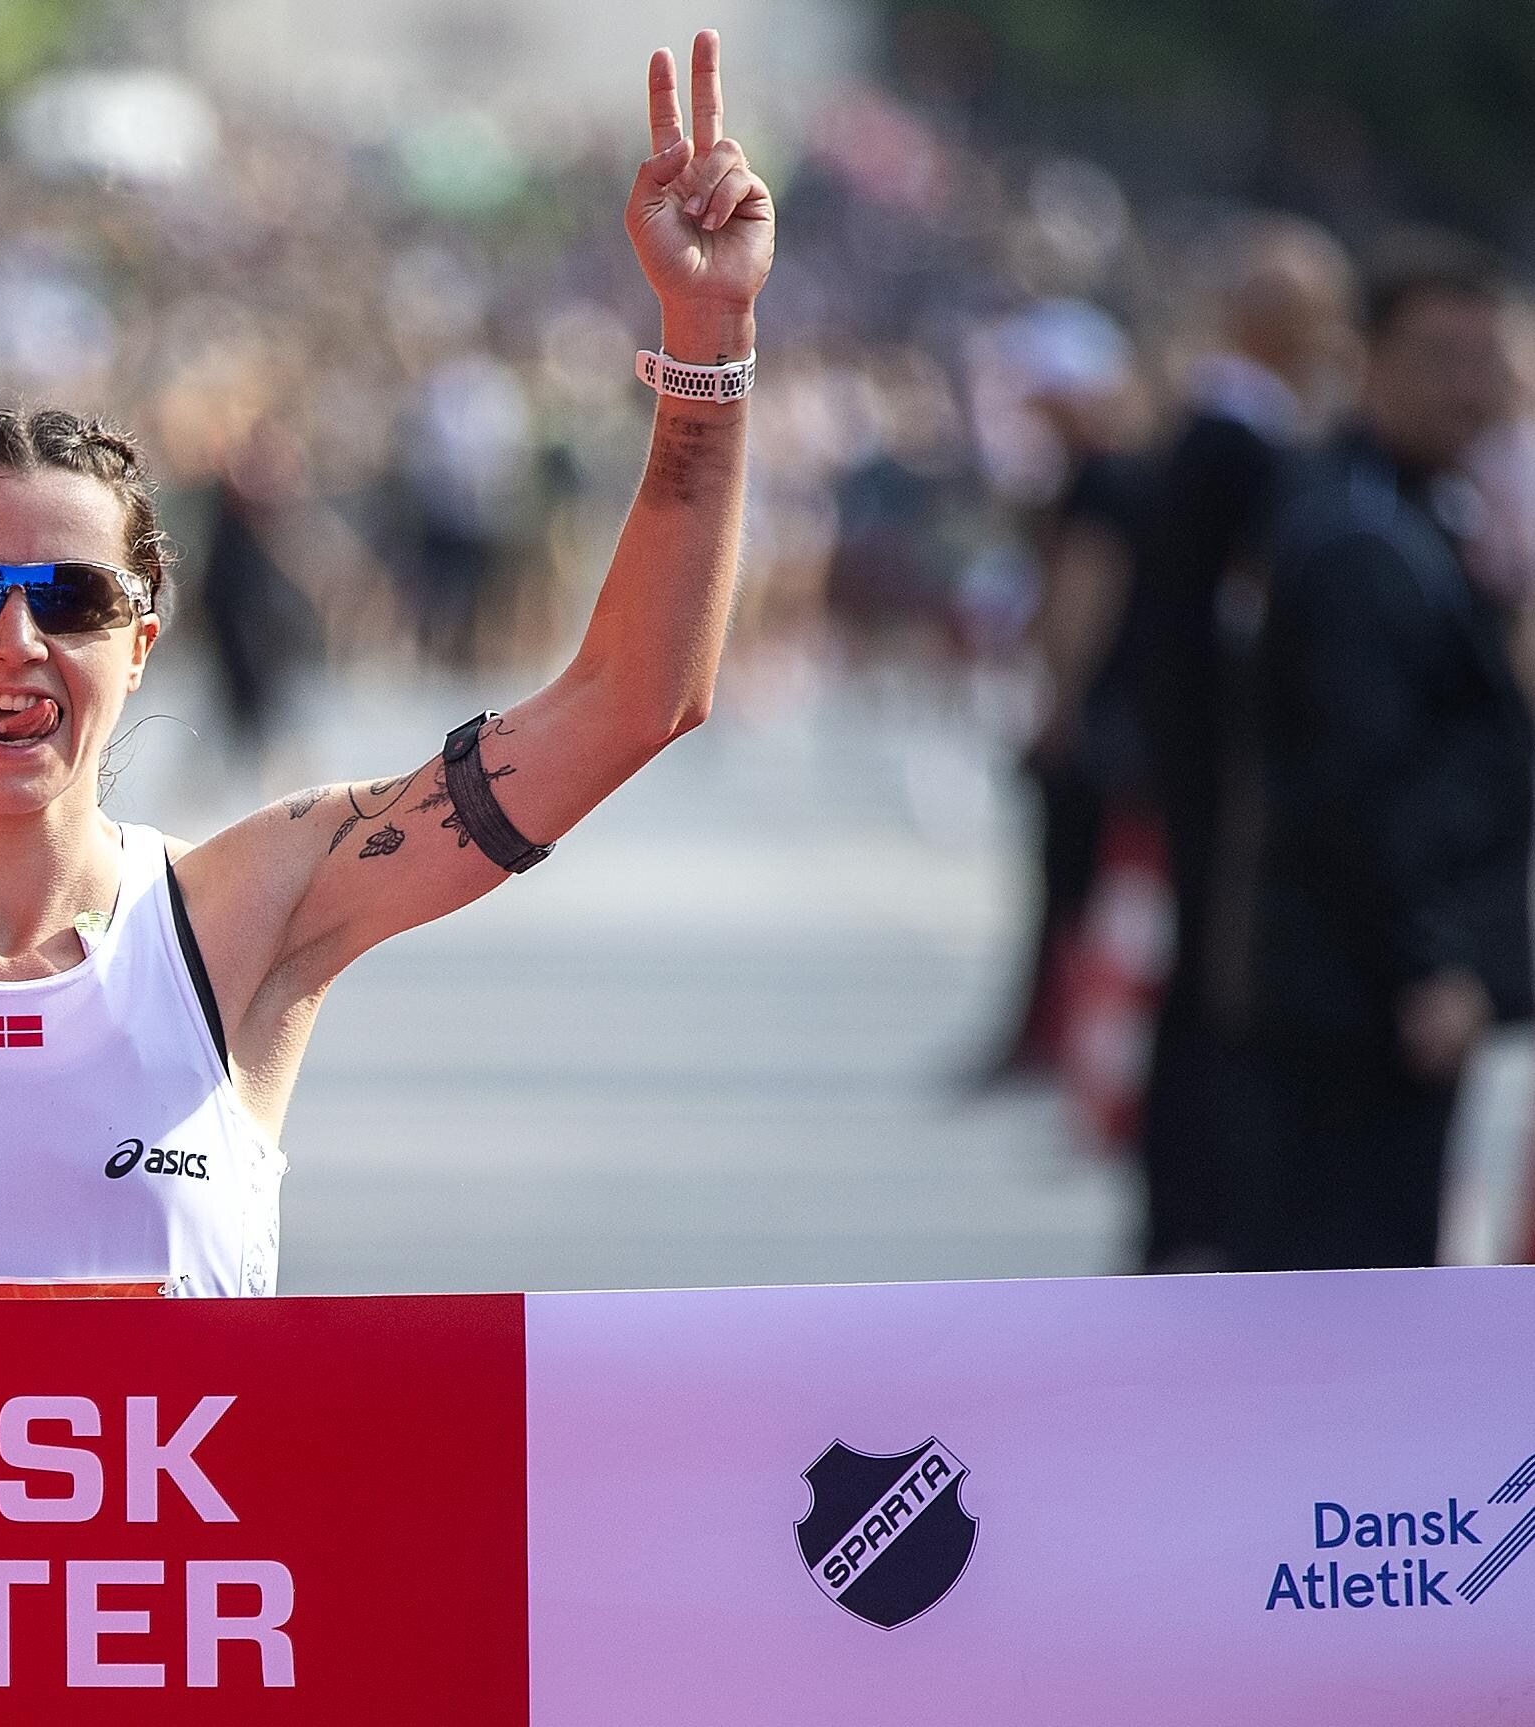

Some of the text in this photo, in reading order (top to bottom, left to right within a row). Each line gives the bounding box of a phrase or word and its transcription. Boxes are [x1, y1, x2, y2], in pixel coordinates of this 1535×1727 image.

[822, 1453, 952, 1589] SPARTA
[1314, 1497, 1483, 1549] Dansk
[1264, 1558, 1453, 1611] Atletik
